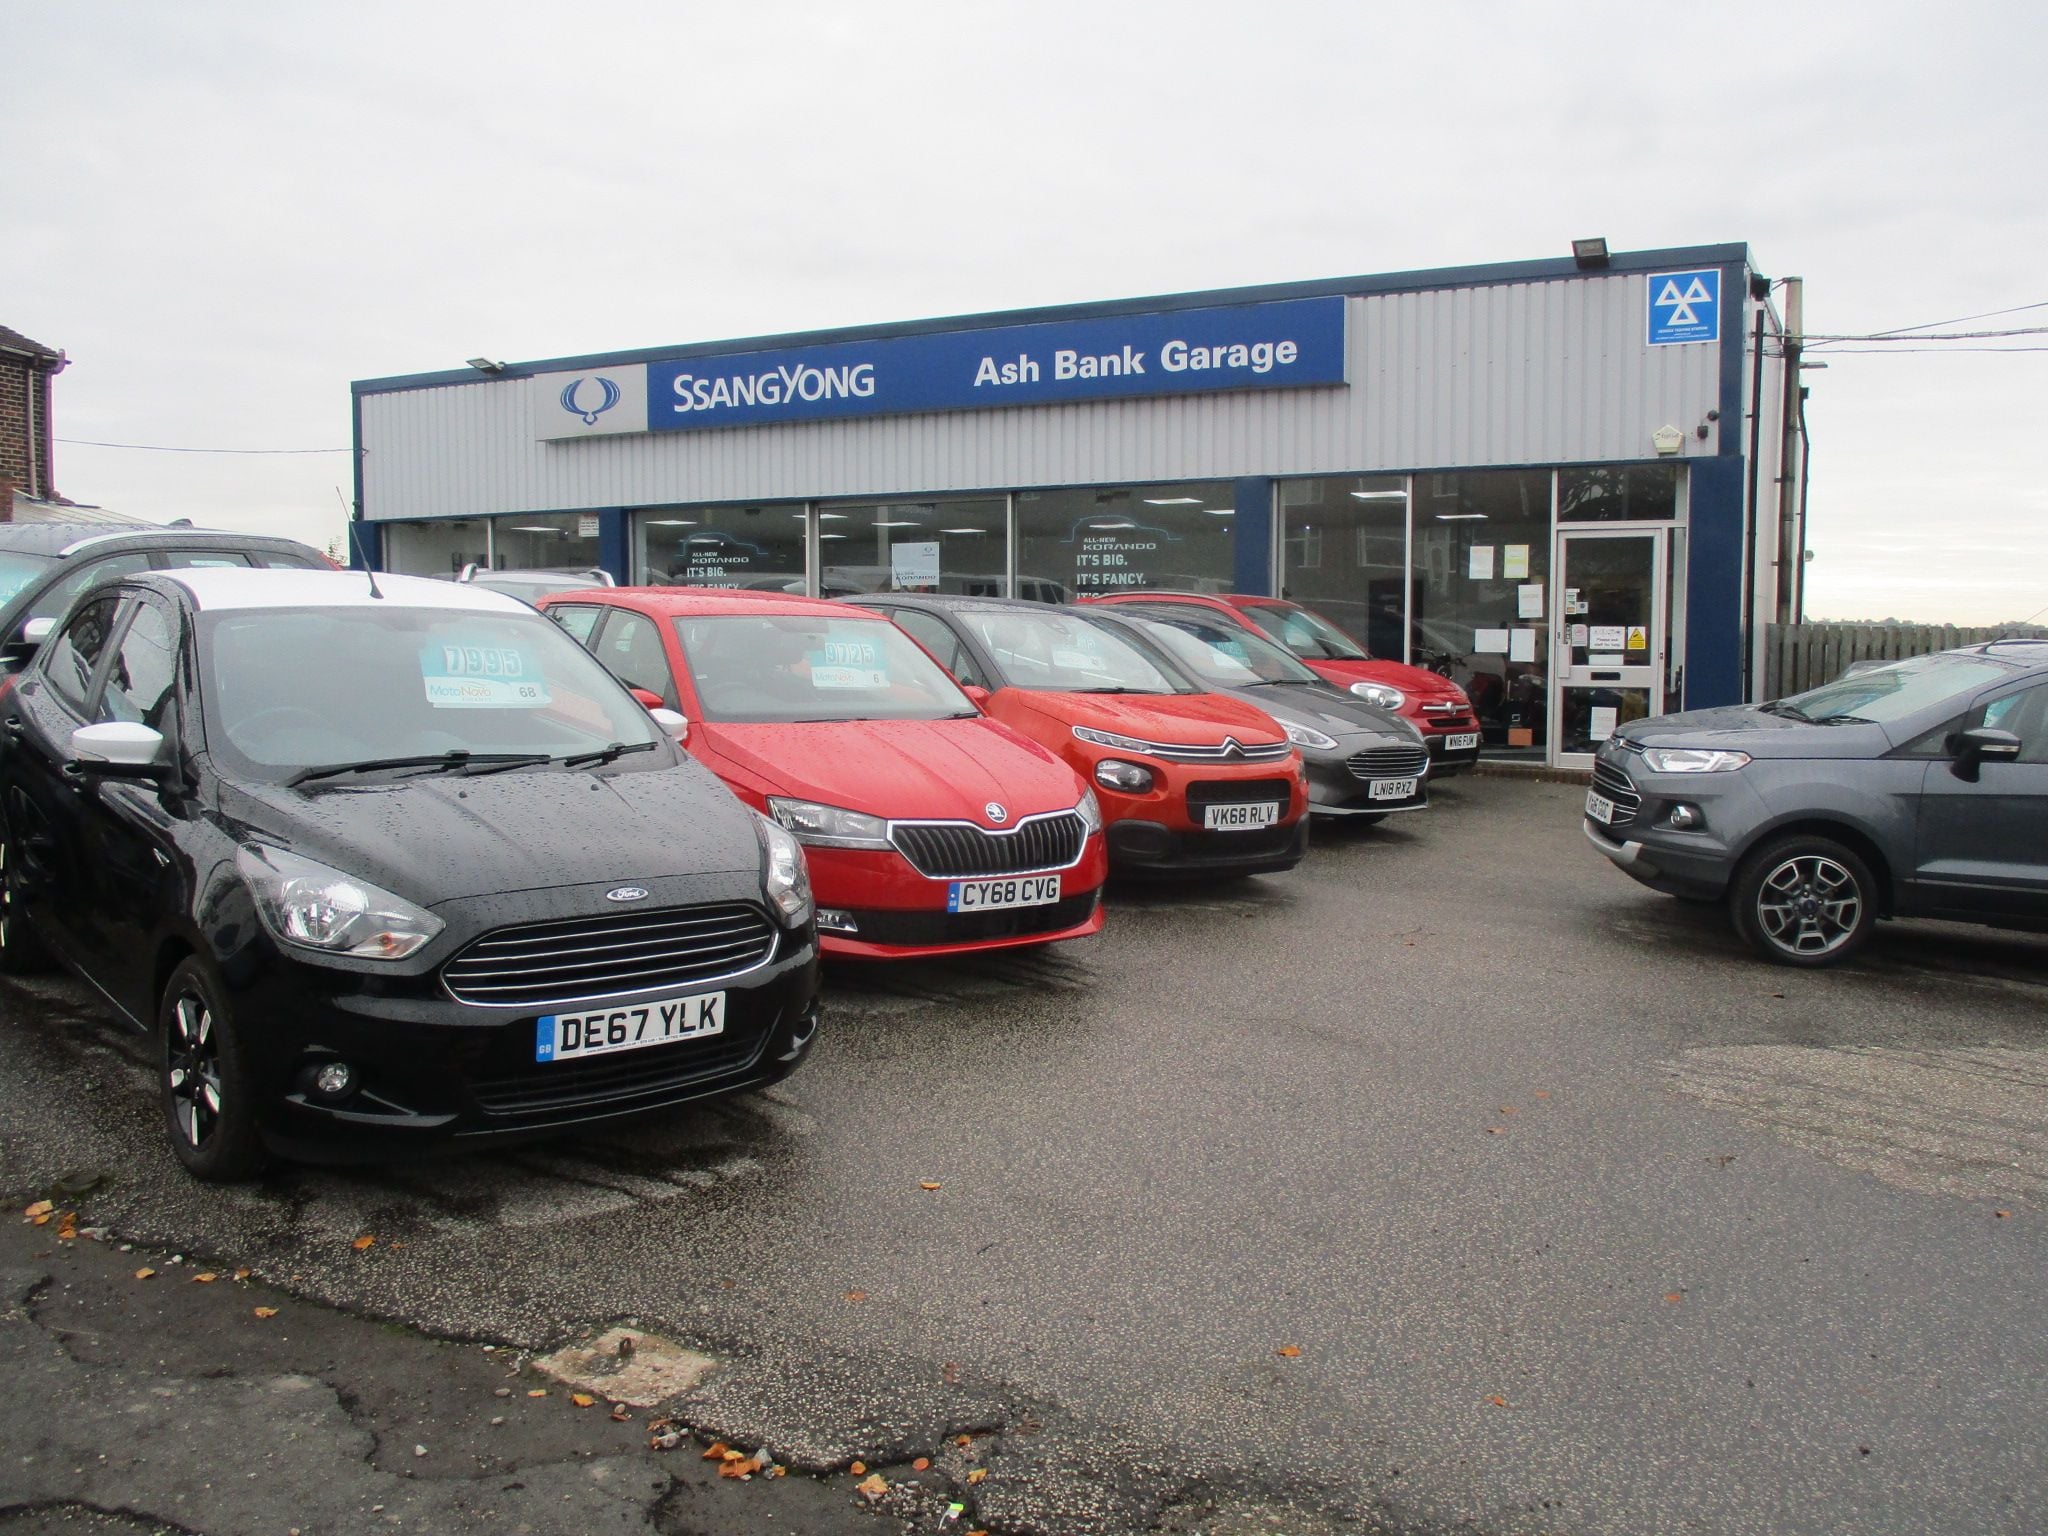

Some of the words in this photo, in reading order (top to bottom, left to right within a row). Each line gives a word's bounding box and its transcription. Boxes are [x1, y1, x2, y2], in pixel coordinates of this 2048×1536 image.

[973, 354, 1040, 387] Ash
[1055, 345, 1145, 380] Bank
[1161, 339, 1298, 373] Garage
[1083, 543, 1157, 551] KORANDO
[1076, 554, 1100, 566] IT'S
[1103, 554, 1128, 566] BIG.
[686, 567, 705, 578] IT'S
[707, 566, 727, 577] BIG.
[1076, 573, 1100, 585] IT'S
[1102, 573, 1147, 585] FANCY.
[429, 685, 492, 697] MotoNovo
[1211, 807, 1247, 825] VK68
[1249, 805, 1274, 824] RLV
[962, 881, 1017, 906] CY68
[1021, 877, 1058, 901] CVG
[560, 1008, 650, 1052] DE67
[660, 997, 718, 1036] YLK
